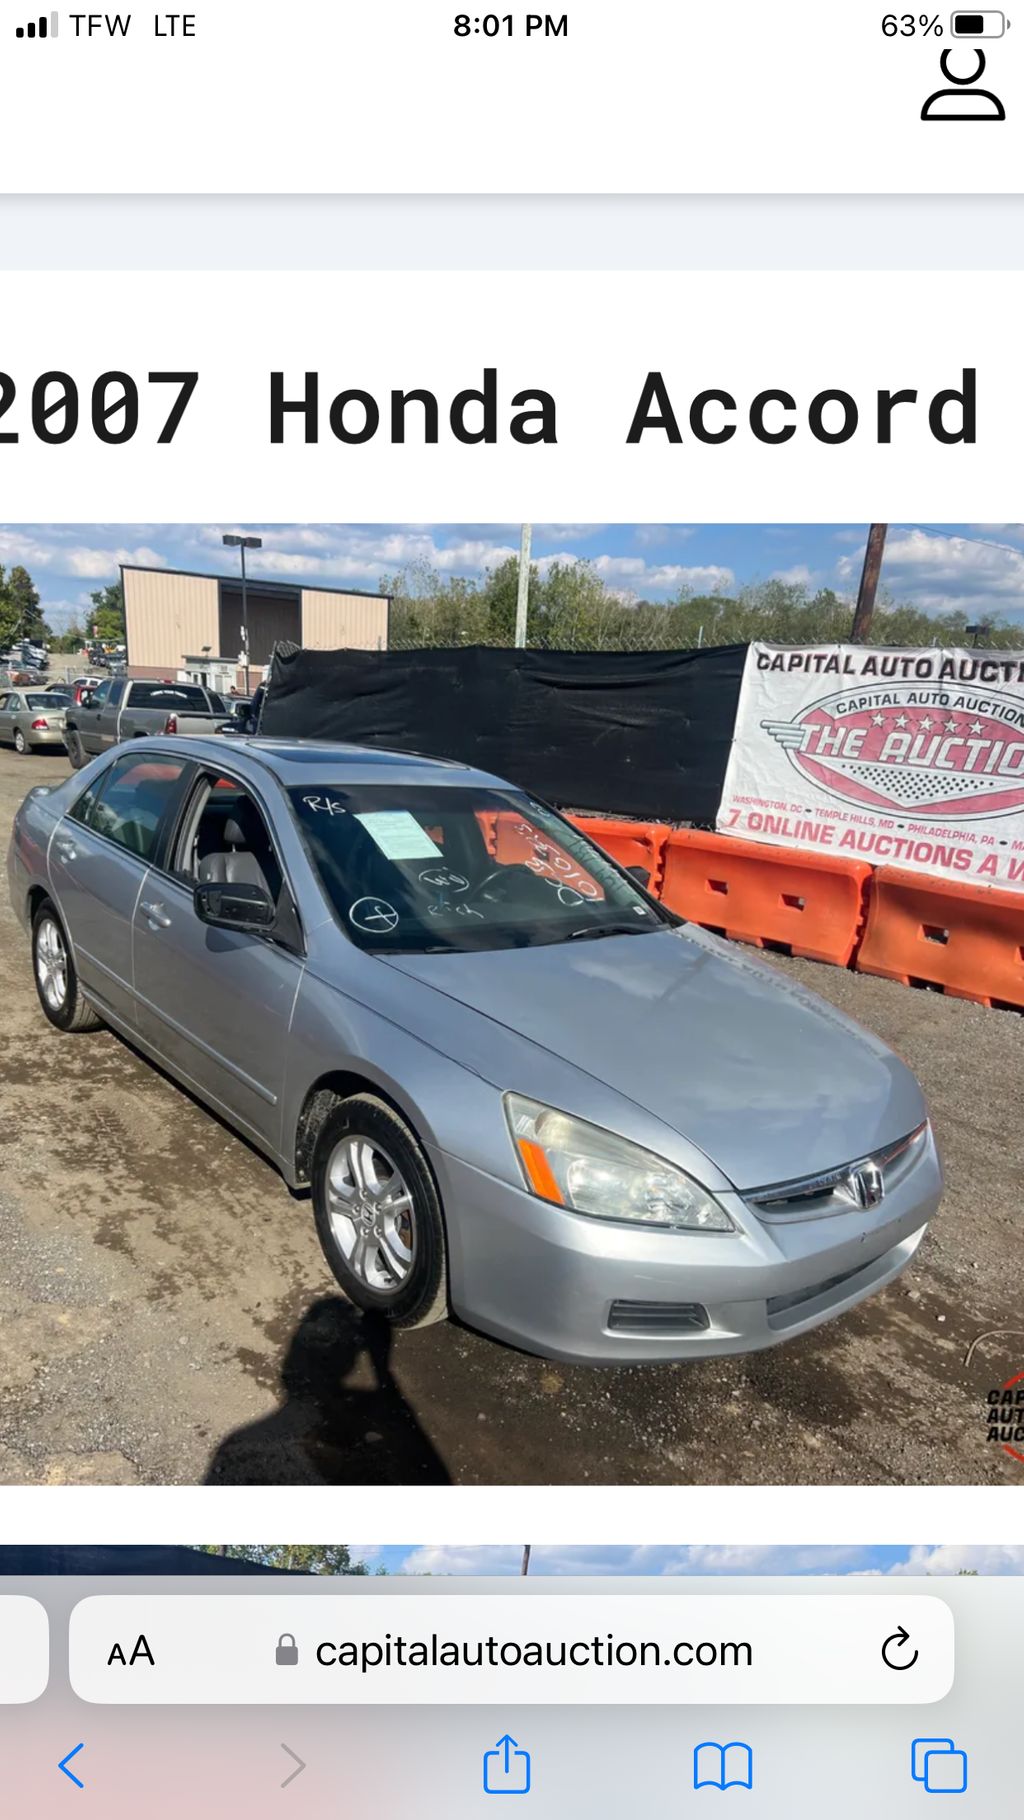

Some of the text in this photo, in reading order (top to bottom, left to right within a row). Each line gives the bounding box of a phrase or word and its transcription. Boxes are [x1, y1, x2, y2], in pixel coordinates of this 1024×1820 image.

[68, 14, 196, 37] TFW LTE
[453, 14, 568, 37] 8:01 PM
[881, 14, 944, 37] 63%
[270, 367, 558, 445] Honda
[625, 367, 977, 445] Accord
[756, 652, 856, 675] CAPITAL
[861, 655, 932, 679] AUTO
[836, 693, 901, 714] CAPITAL
[907, 692, 950, 706] AUTO
[799, 722, 869, 758] THE
[789, 803, 803, 814] DC
[815, 807, 850, 822] TEMPLE
[878, 818, 895, 829] MD
[980, 835, 995, 846] PA
[728, 808, 742, 827] 7
[747, 811, 836, 846] ONLINE
[838, 828, 974, 872] AUCTIONS
[977, 853, 998, 877] A
[316, 1633, 752, 1674] capitalautoauction.com
